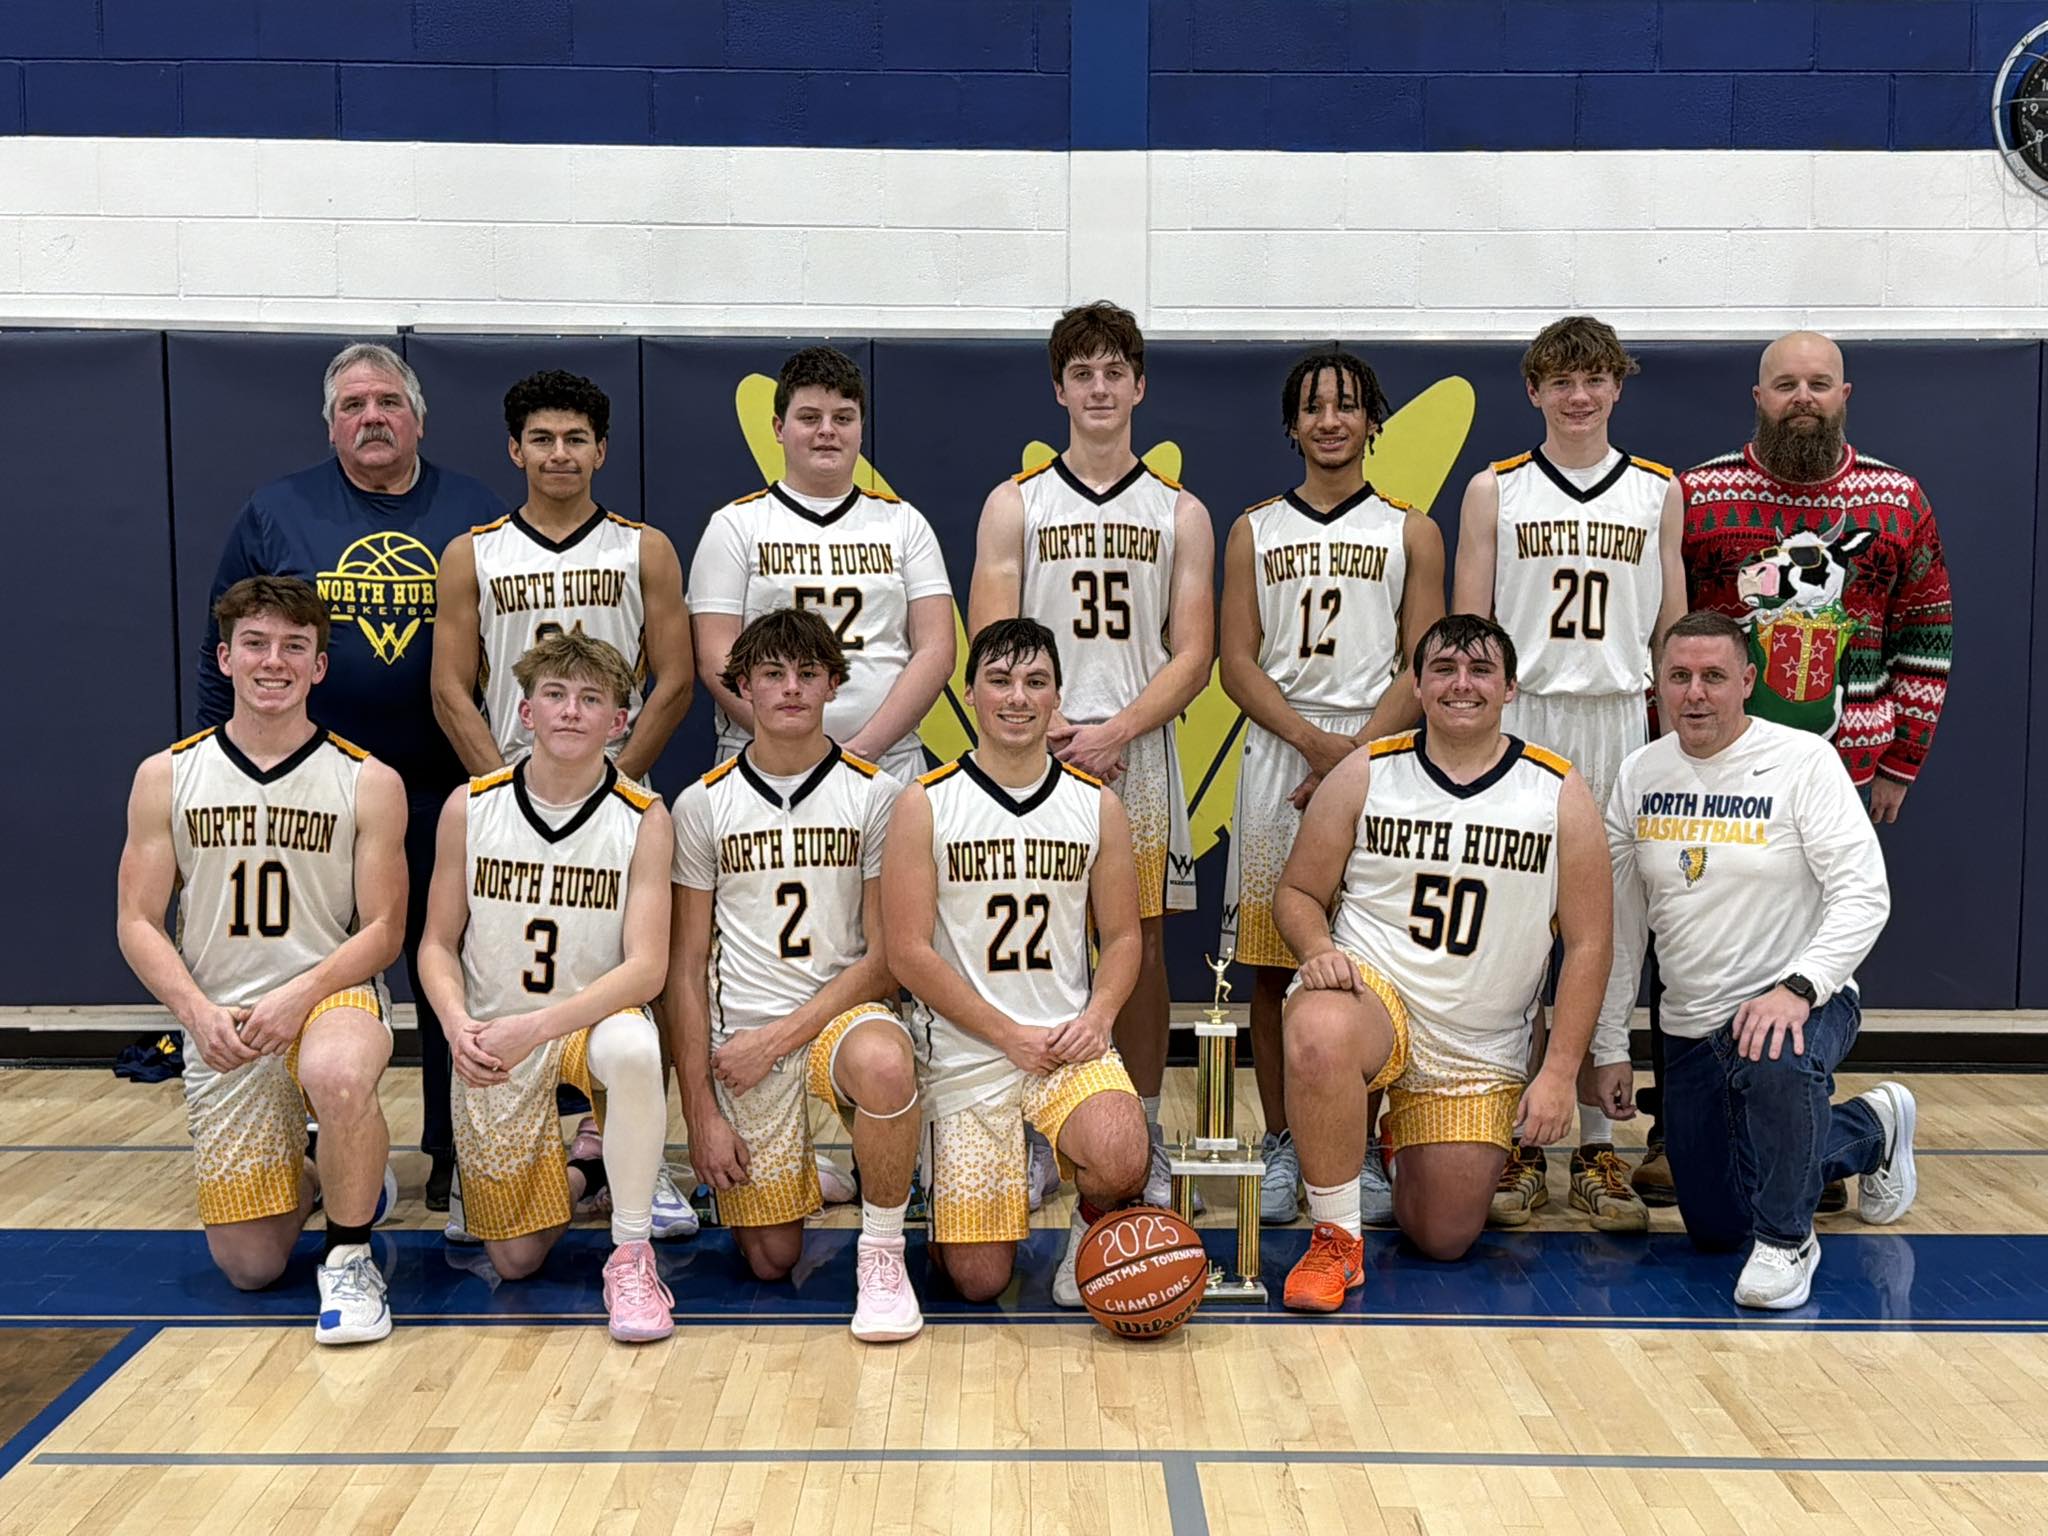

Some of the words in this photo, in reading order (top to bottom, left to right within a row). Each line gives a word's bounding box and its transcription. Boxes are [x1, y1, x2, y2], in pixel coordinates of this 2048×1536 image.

[2030, 103, 2039, 116] 9
[2035, 129, 2044, 143] 8
[757, 541, 822, 575] NORTH
[829, 541, 894, 576] HURON
[1037, 522, 1096, 563] NORTH
[1103, 522, 1162, 564] HURON
[1263, 541, 1321, 586] NORTH
[1329, 541, 1389, 583] HURON
[1515, 520, 1580, 560] NORTH
[1587, 521, 1648, 566] HURON
[316, 579, 385, 604] NORTH
[393, 582, 436, 604] HUR
[331, 604, 433, 616] ASKETBA
[490, 570, 555, 616] NORTH
[562, 568, 627, 608] HURON
[1071, 569, 1132, 641] 35
[1549, 568, 1610, 642] 20
[1300, 586, 1342, 659] 12
[184, 804, 257, 849] NORTH
[266, 805, 338, 854] HURON
[1638, 792, 1698, 816] NORTH
[1702, 793, 1774, 821] HURON
[720, 828, 785, 875] NORTH
[792, 825, 861, 869] HURON
[1364, 815, 1454, 864] NORTH
[1460, 823, 1553, 875] HURON
[1637, 816, 1770, 846] BASKETBALL
[472, 855, 545, 904] NORTH
[551, 864, 623, 911] HURON
[946, 837, 1017, 882] NORTH
[1024, 838, 1091, 882] HURON
[227, 859, 290, 939] 10
[775, 880, 813, 961] 2
[1408, 871, 1490, 959] 50
[520, 917, 561, 995] 3
[985, 892, 1054, 974] 22
[1098, 1214, 1180, 1267] 2025
[1085, 1260, 1148, 1296] CHRISTMAS
[1105, 1275, 1191, 1313] CHAMPIONS
